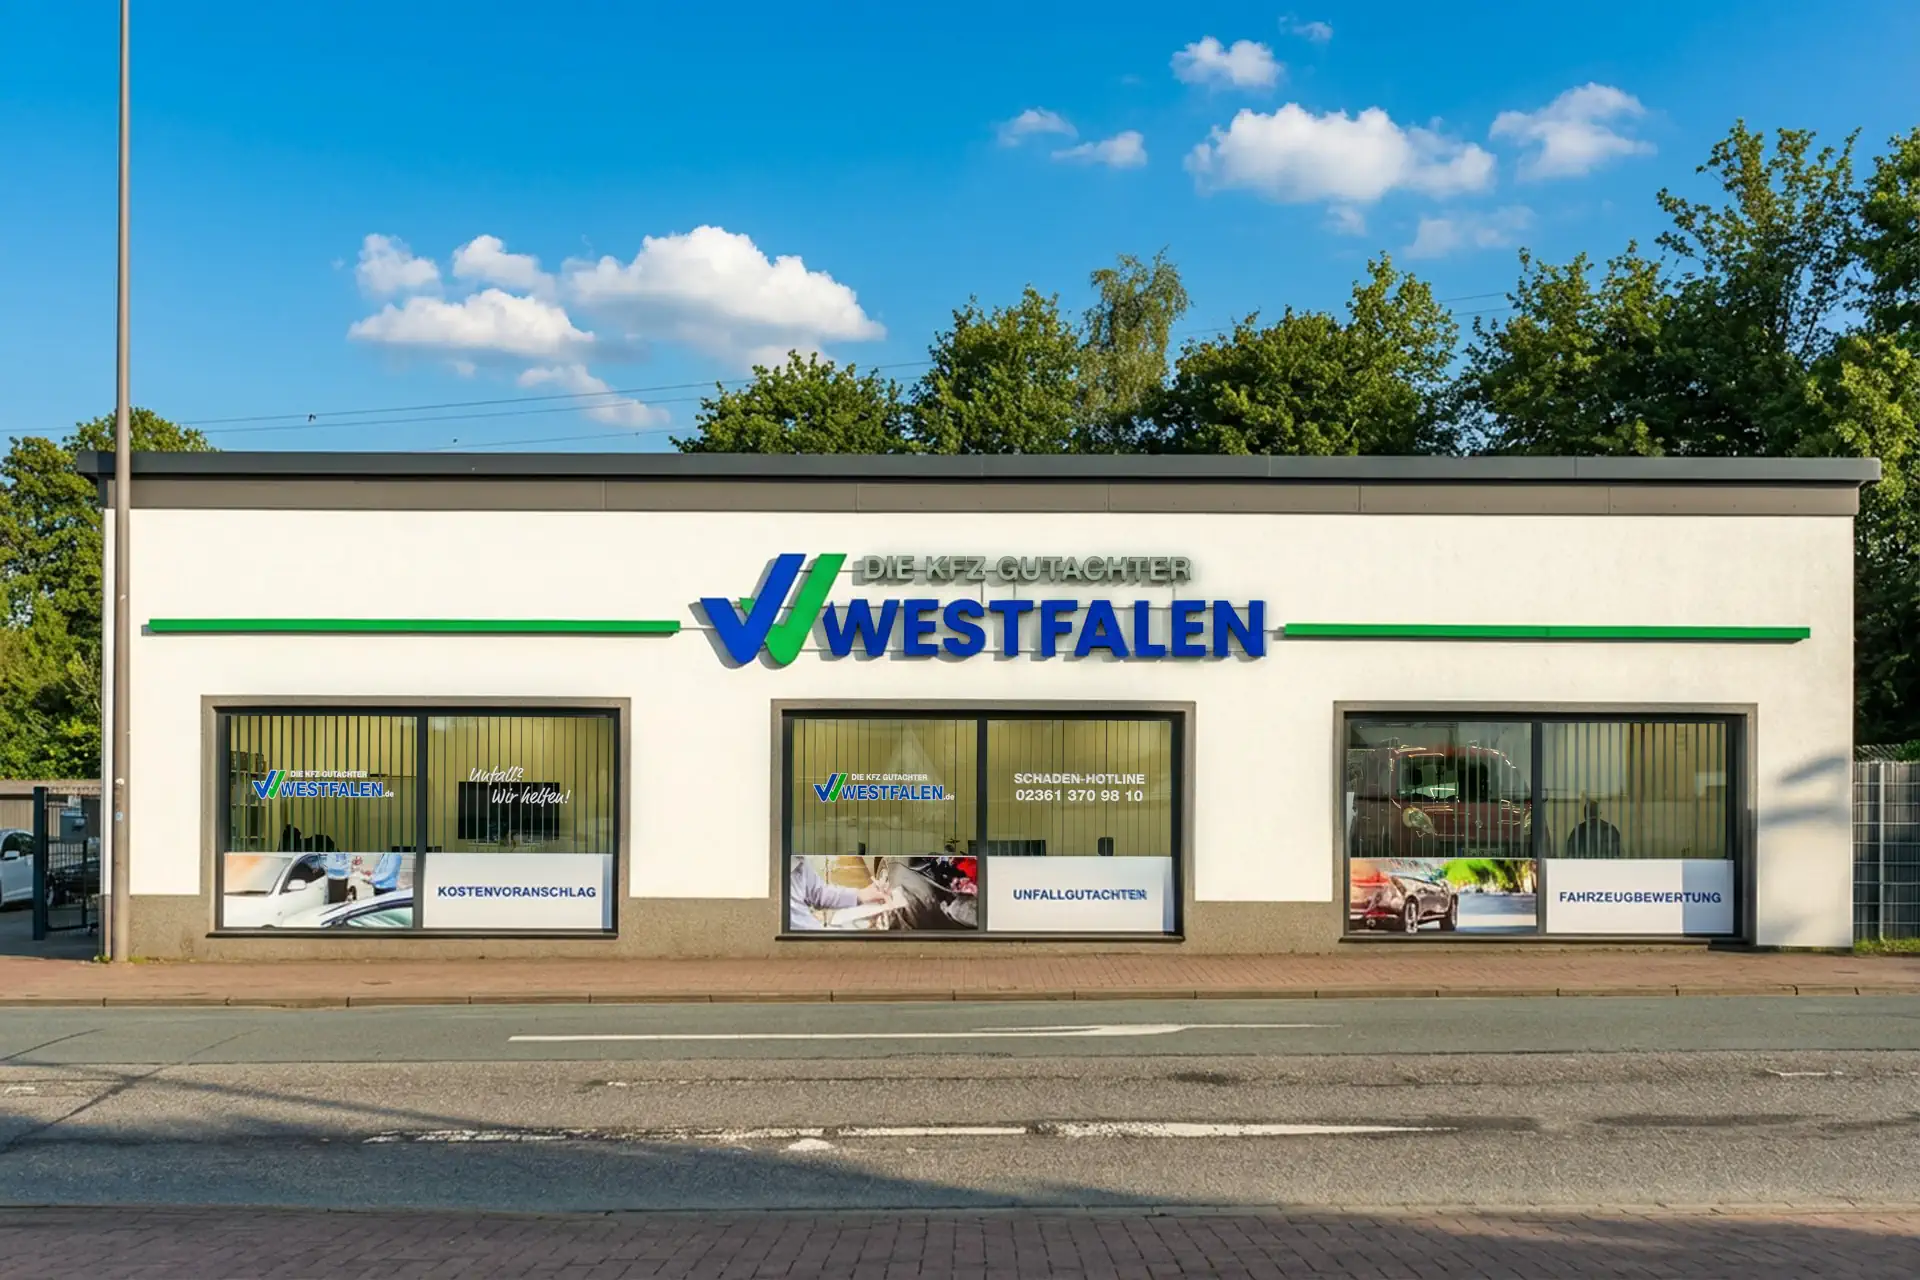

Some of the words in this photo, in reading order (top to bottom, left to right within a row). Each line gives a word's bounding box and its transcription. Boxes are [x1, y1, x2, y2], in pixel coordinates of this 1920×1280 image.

[863, 555, 915, 580] DIE
[925, 555, 986, 580] KFZ
[996, 555, 1192, 581] GUTACHTER
[821, 598, 1267, 658] WESTFALEN
[290, 770, 304, 778] DIE
[305, 770, 320, 778] KFZ
[321, 770, 368, 778] GUTACHTER
[469, 765, 524, 785] Unfall?
[851, 773, 865, 781] DIE
[866, 773, 881, 781] KFZ
[883, 773, 928, 781] GUTACHTER
[1013, 772, 1146, 785] SCHADEN-HOTLINE
[491, 788, 518, 804] Wir
[520, 786, 571, 807] helfen!
[1015, 789, 1061, 802] 02361
[1067, 789, 1096, 802] 370
[1100, 789, 1120, 802] 98
[1125, 789, 1144, 802] 10
[437, 884, 597, 898] KOSTENVORANSCHLAG
[1013, 888, 1148, 901] UNFALLGUTACHTEN
[1559, 891, 1722, 904] FAHRZEUGBEWERTUNG
